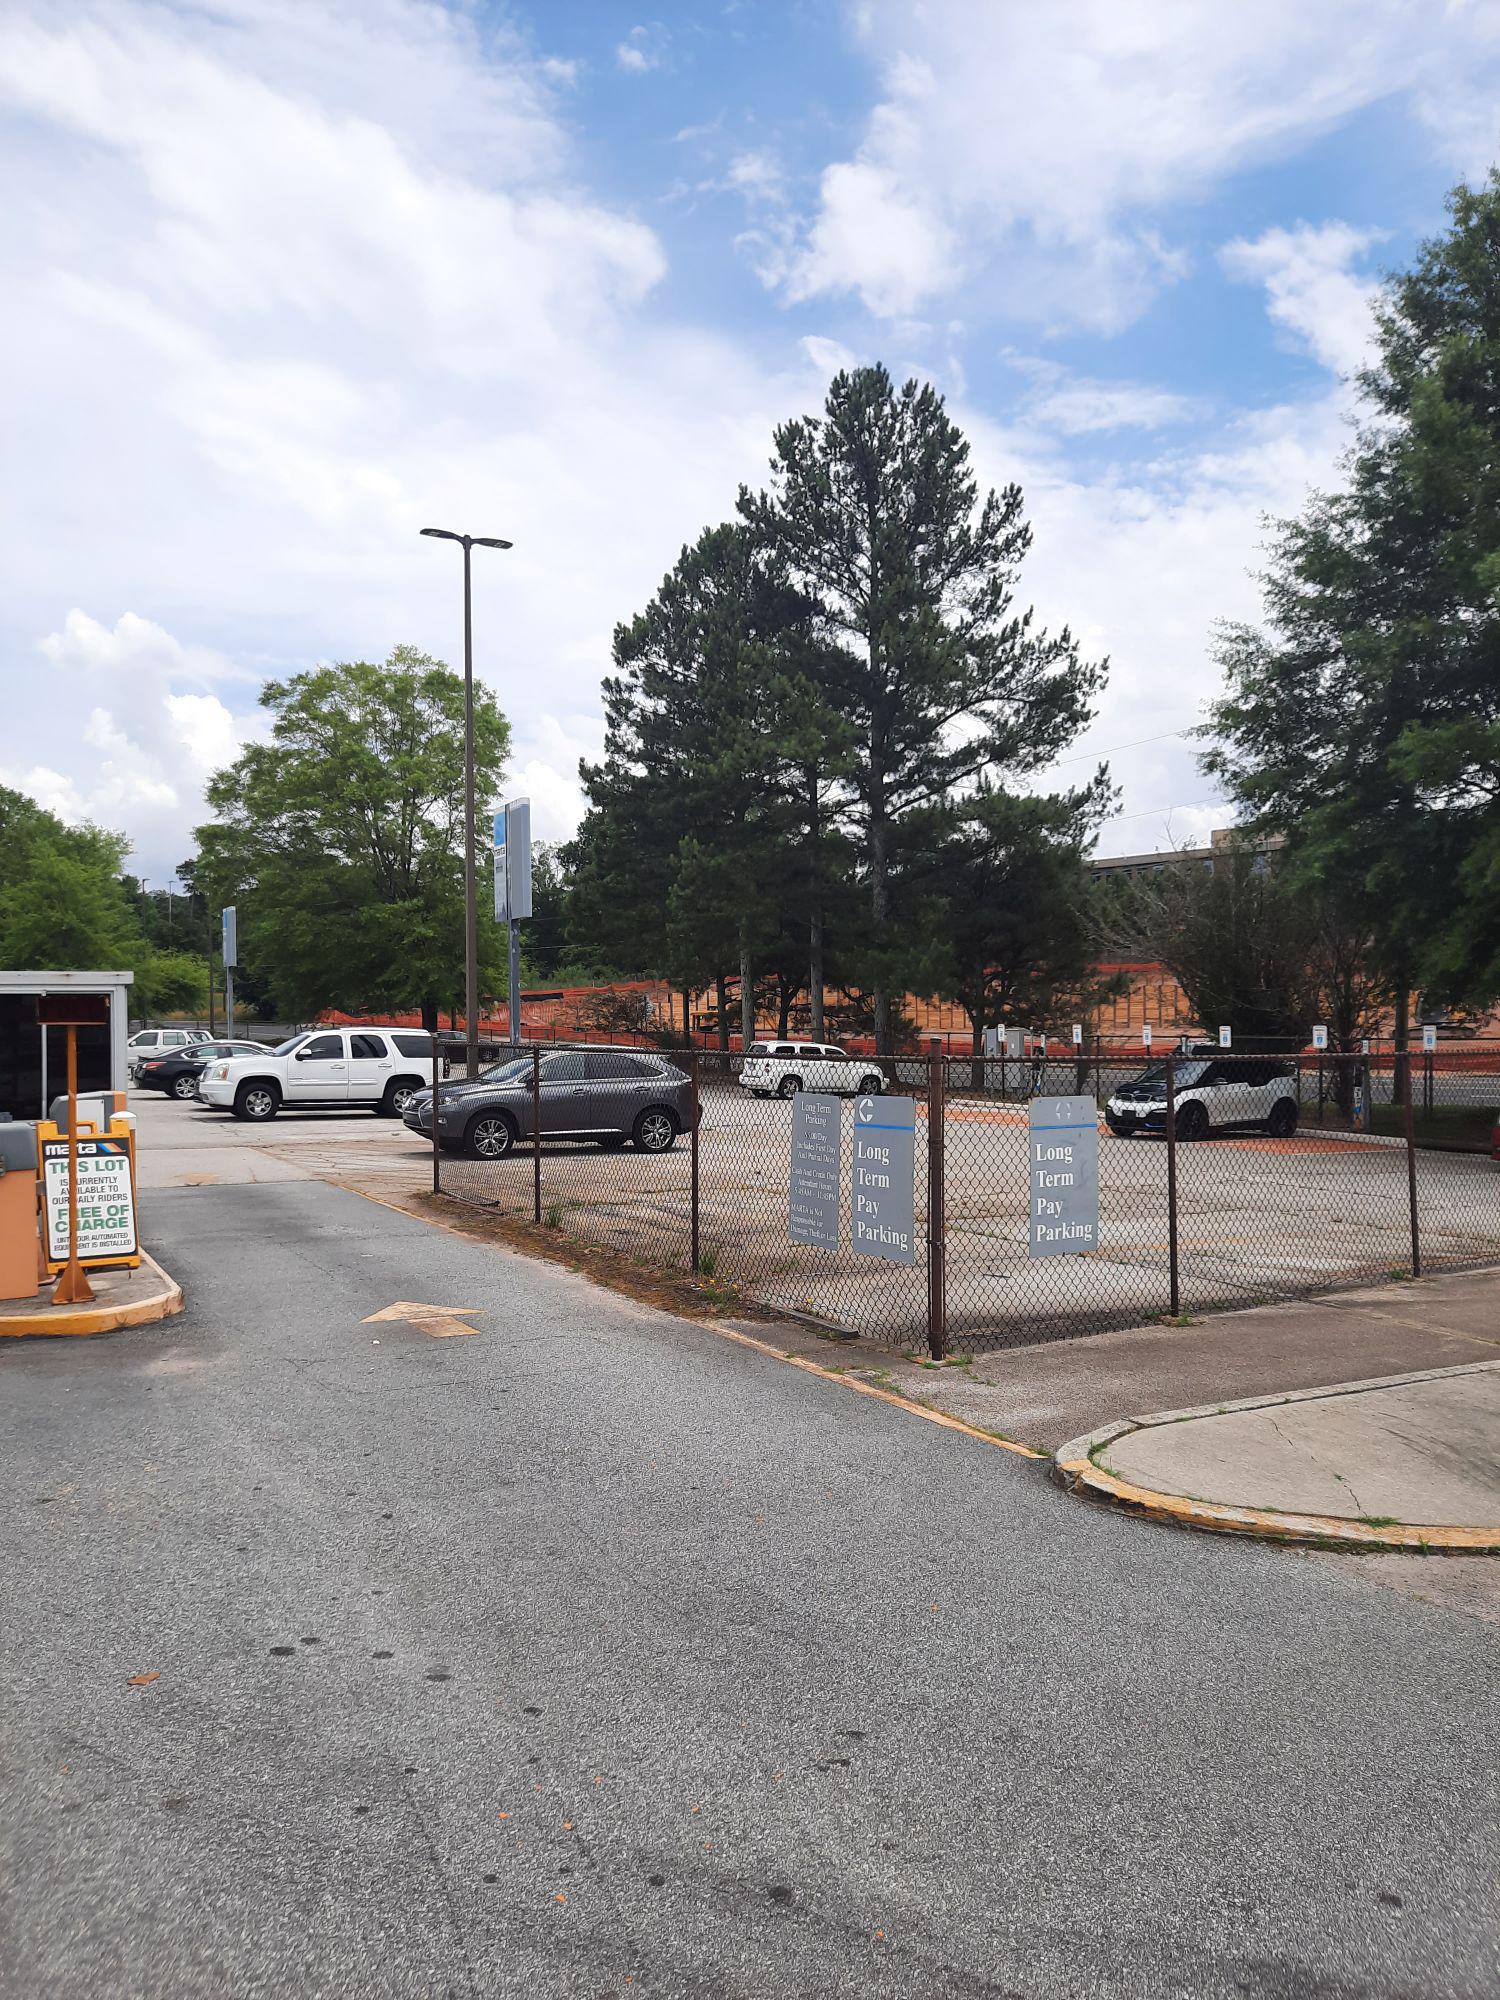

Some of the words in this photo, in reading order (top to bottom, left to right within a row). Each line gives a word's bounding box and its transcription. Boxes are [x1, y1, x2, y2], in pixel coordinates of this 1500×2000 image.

[801, 1101, 816, 1115] Long
[816, 1102, 831, 1113] Term
[805, 1114, 827, 1127] Parking
[45, 1143, 97, 1155] mata
[857, 1141, 890, 1166] Long
[1035, 1143, 1073, 1164] Long
[49, 1159, 89, 1174] THS
[95, 1159, 126, 1172] LOT
[60, 1178, 69, 1187] IS
[71, 1176, 118, 1187] URRENTLY
[857, 1167, 890, 1188] Term
[1035, 1170, 1074, 1188] Term
[60, 1185, 106, 1196] AVILABLE
[108, 1184, 118, 1193] TO
[71, 1194, 95, 1204] AILY
[98, 1193, 128, 1203] RIDERS
[857, 1194, 880, 1218] Pay
[57, 1205, 102, 1220] FEE
[107, 1204, 129, 1217] OF
[791, 1203, 809, 1214] MARTA
[1036, 1198, 1064, 1218] Pay
[55, 1217, 129, 1233] CARGE
[1036, 1221, 1093, 1242] Parking
[91, 1232, 128, 1241] AUTOMATED
[857, 1220, 908, 1251] Parking
[54, 1242, 90, 1251] EQUIENT
[92, 1241, 98, 1249] IS
[99, 1240, 131, 1248] INSTALLED
